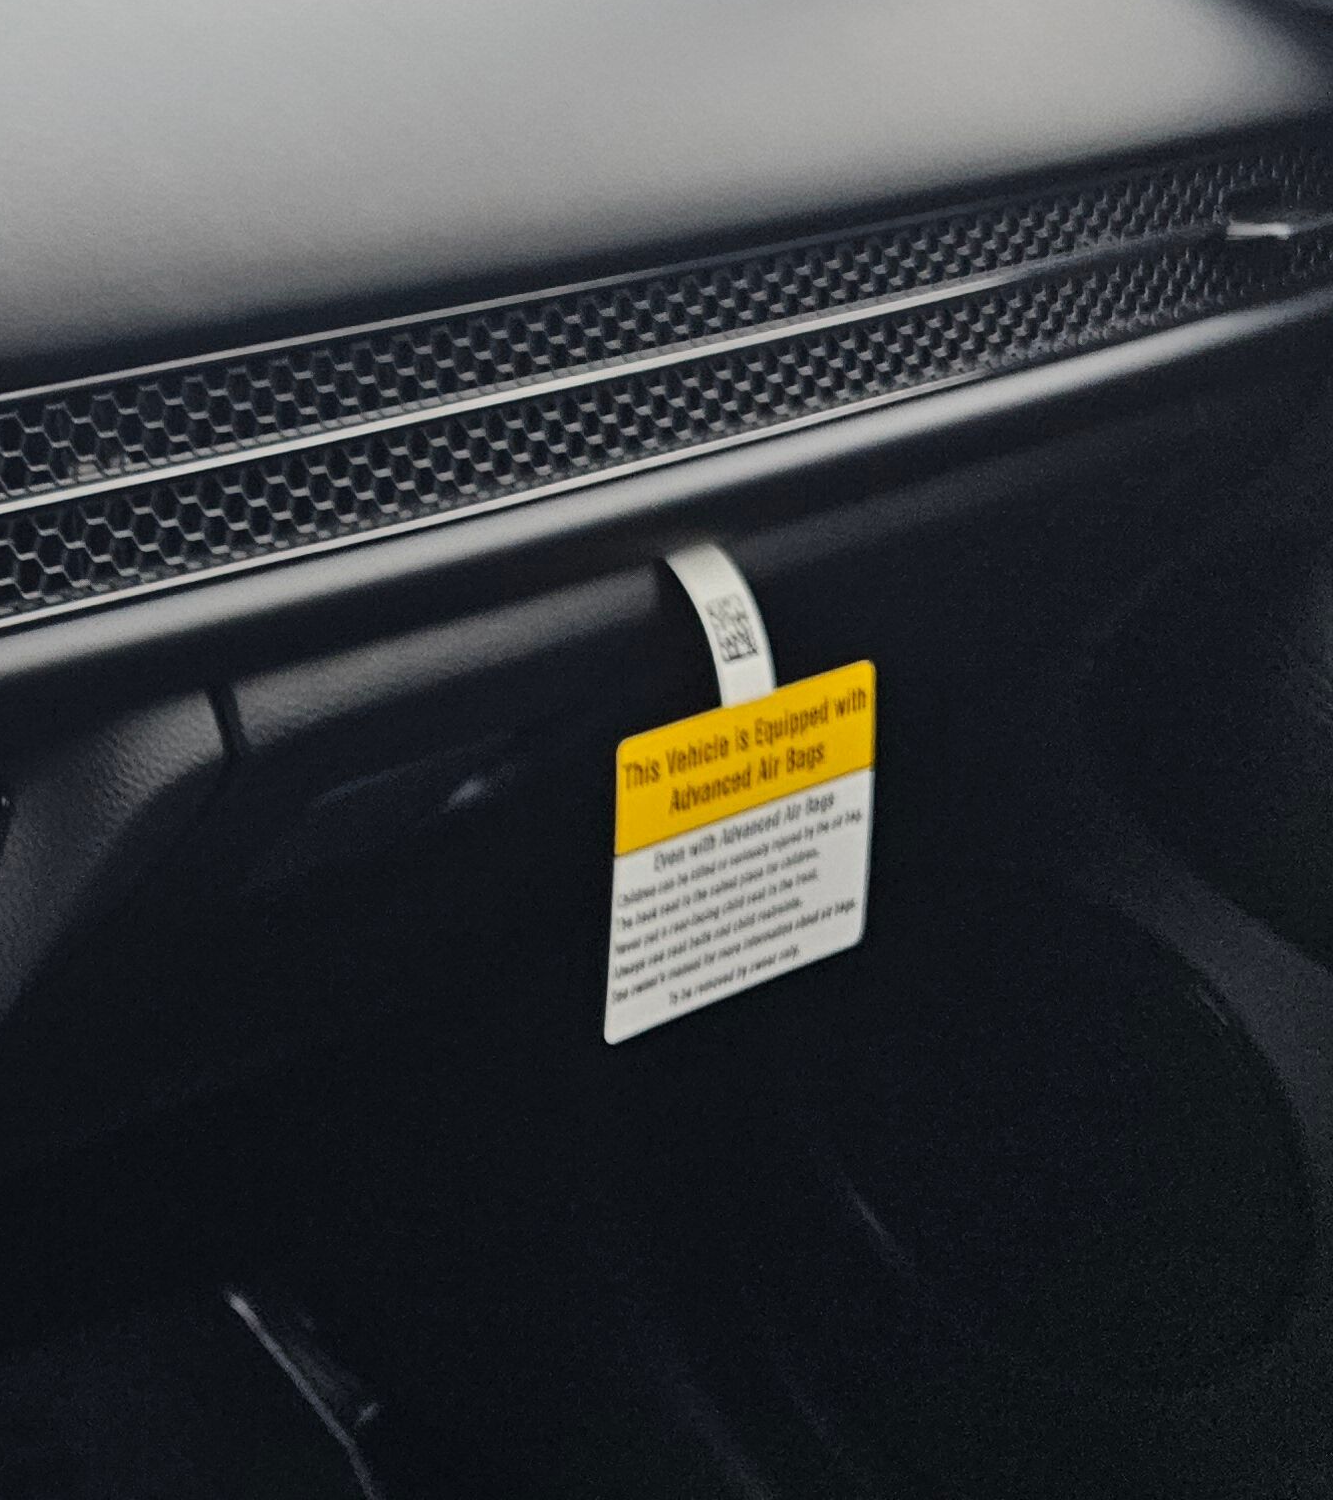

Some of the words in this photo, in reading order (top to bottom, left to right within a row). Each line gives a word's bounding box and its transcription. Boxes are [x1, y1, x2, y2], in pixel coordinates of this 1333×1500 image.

[622, 757, 660, 791] This
[665, 733, 730, 775] Vehicle
[735, 724, 749, 752] is
[754, 699, 829, 746] Equipped
[835, 687, 867, 718] with
[669, 763, 752, 814] Advanced
[757, 752, 780, 782] Air
[786, 741, 825, 773] Bags
[721, 810, 780, 846] Advanced
